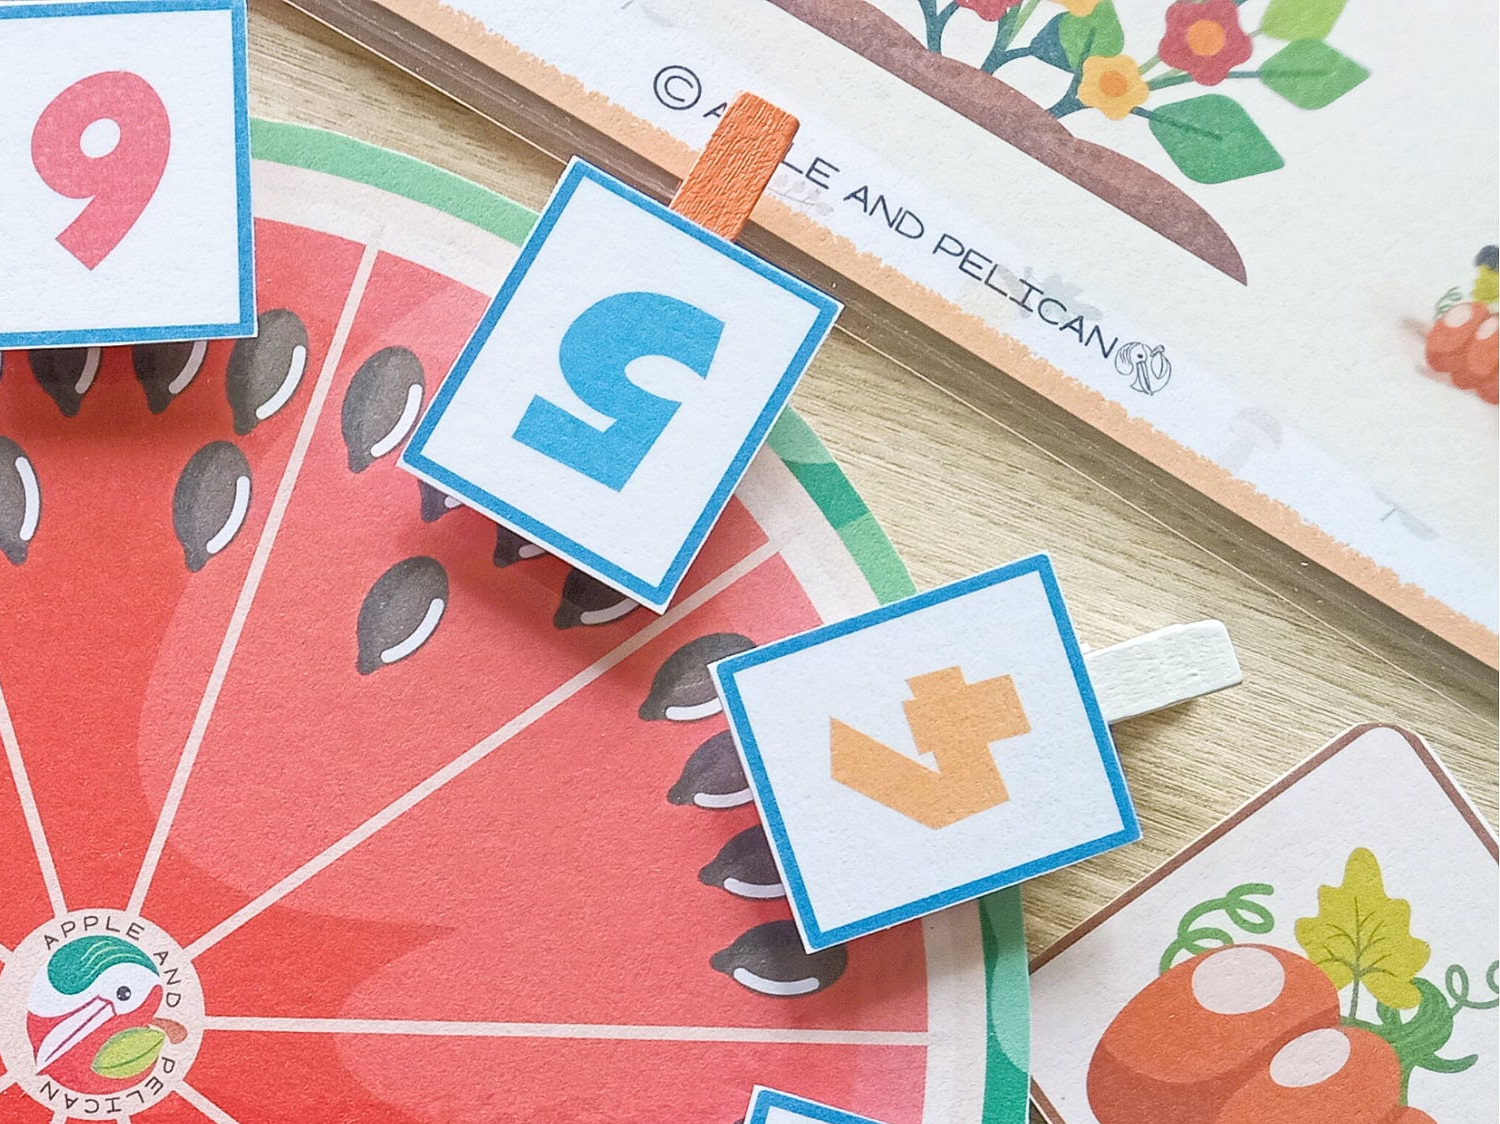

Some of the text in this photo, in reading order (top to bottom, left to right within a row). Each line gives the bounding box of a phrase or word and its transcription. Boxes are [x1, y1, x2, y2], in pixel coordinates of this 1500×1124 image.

[703, 101, 840, 190] ALE
[843, 183, 925, 241] AND
[932, 232, 1119, 360] PELICAN
[511, 290, 727, 493] 5
[832, 668, 1028, 827] 4
[39, 915, 182, 1114] APPLE AND PELICAN
